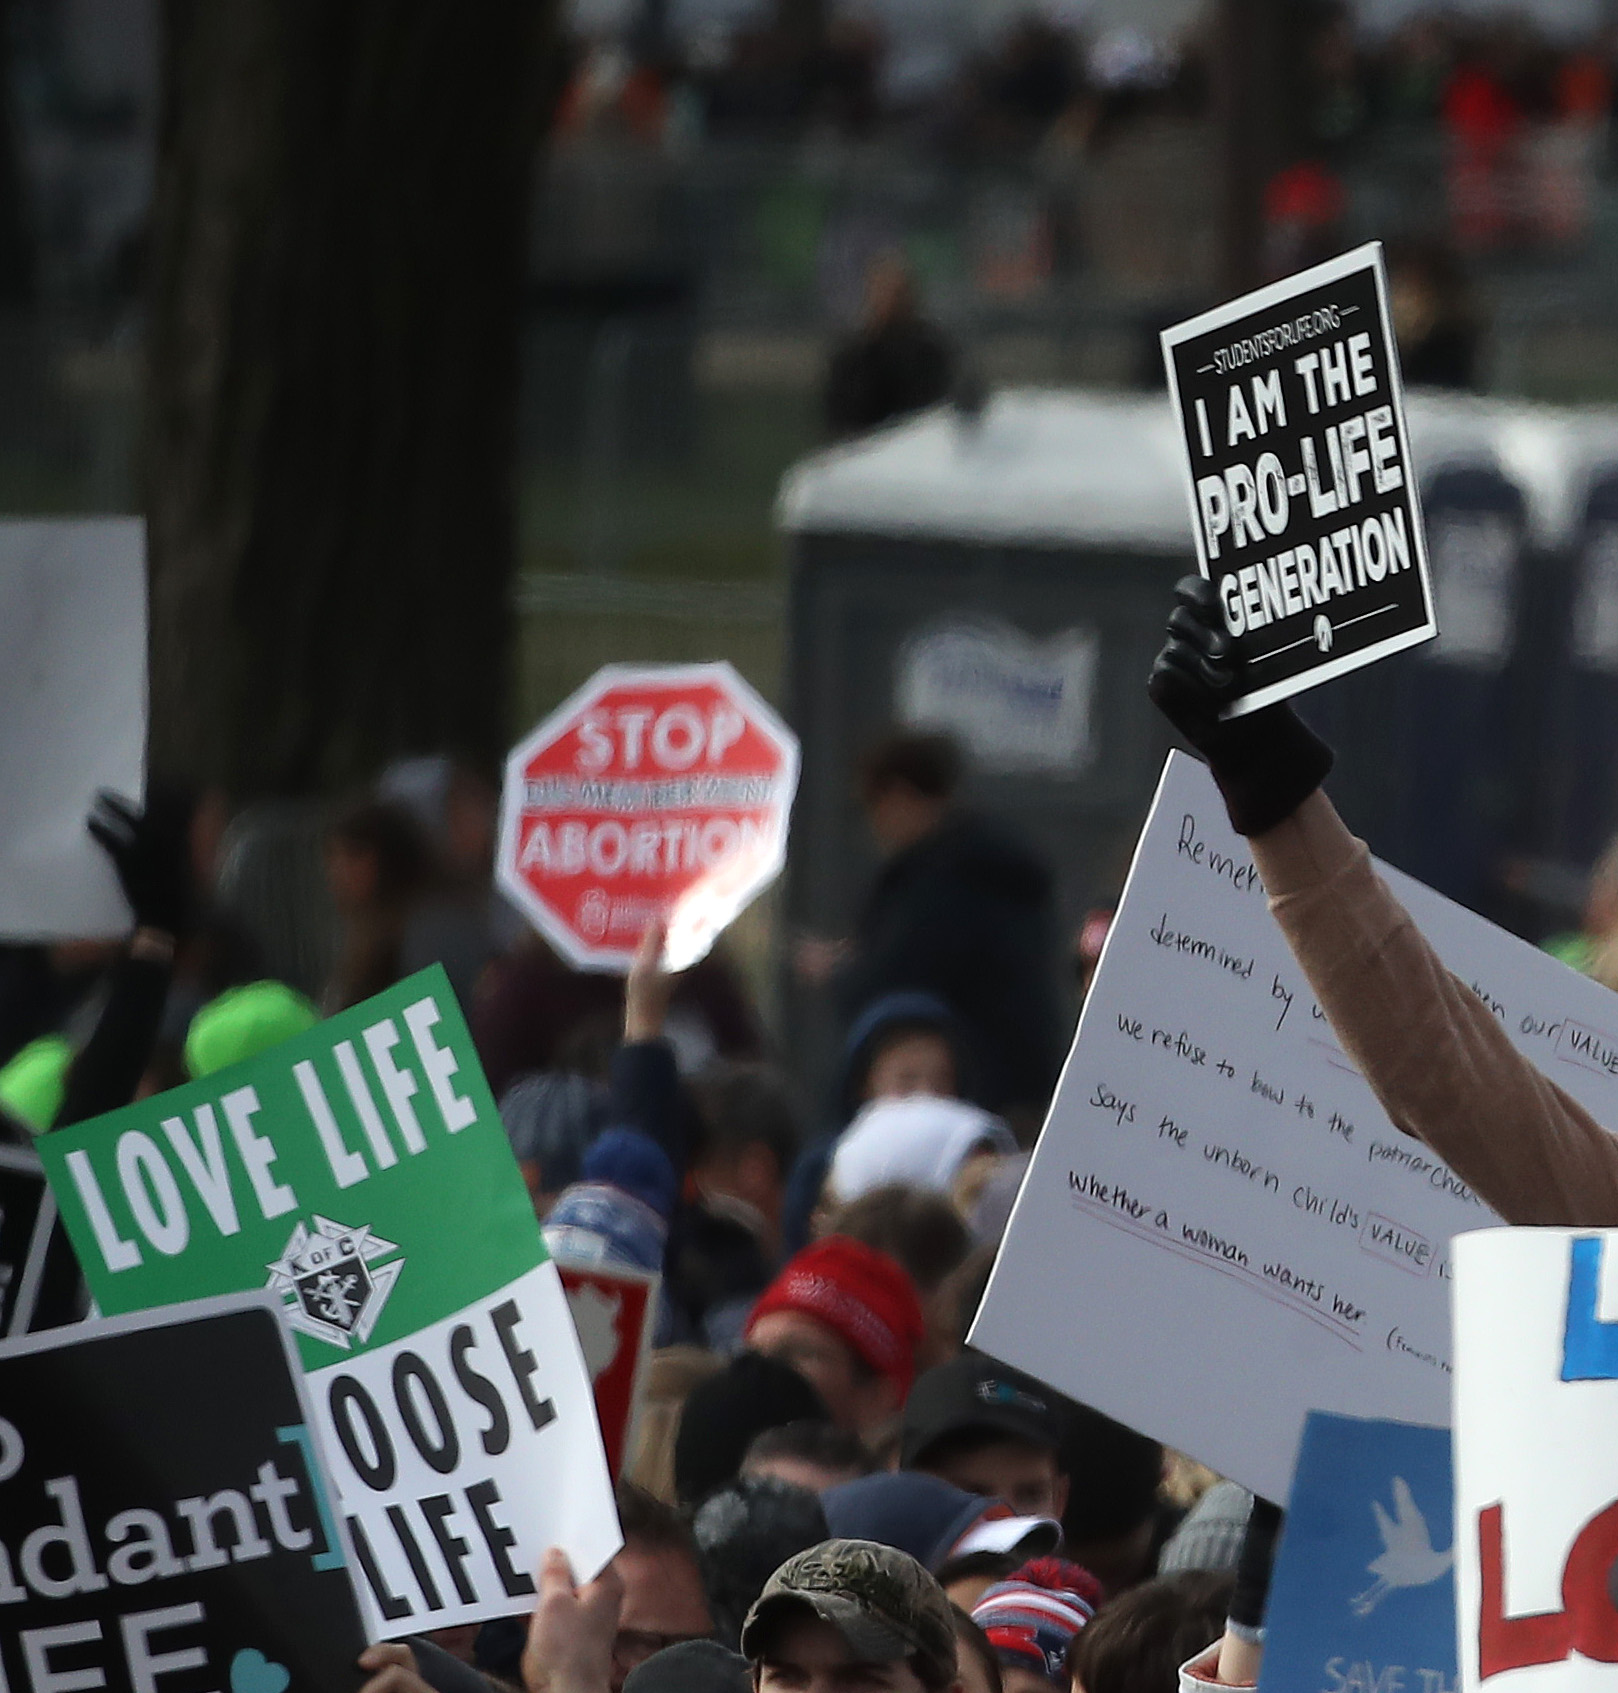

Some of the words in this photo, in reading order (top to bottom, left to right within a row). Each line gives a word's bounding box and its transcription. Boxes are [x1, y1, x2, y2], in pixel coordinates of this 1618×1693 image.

[1194, 397, 1214, 457] I
[1227, 367, 1288, 448] AM
[1294, 330, 1378, 415] THE
[1197, 404, 1405, 560] PRO-LIFE
[1219, 506, 1412, 638] GENERATION
[576, 700, 747, 776] STOP
[521, 818, 782, 876] ABORTION
[1150, 912, 1256, 979] determined
[1270, 973, 1295, 1032] by
[1519, 1014, 1563, 1039] our
[64, 1084, 300, 1274] LOVE
[292, 995, 479, 1190] LIFE
[1150, 1030, 1207, 1067] refuse
[1216, 1056, 1236, 1079] to
[1294, 1093, 1315, 1119] to
[1327, 1113, 1356, 1145] the
[1367, 1140, 1486, 1208] patriarcha
[1158, 1115, 1188, 1148] the
[1203, 1142, 1280, 1193] unborn
[1371, 1223, 1431, 1267] VALUE
[1154, 1212, 1171, 1230] a
[1181, 1223, 1251, 1268] woman
[1262, 1262, 1325, 1303] wants
[1332, 1291, 1368, 1324] her
[328, 1298, 558, 1492] OOSE
[345, 1478, 537, 1622] LIFE
